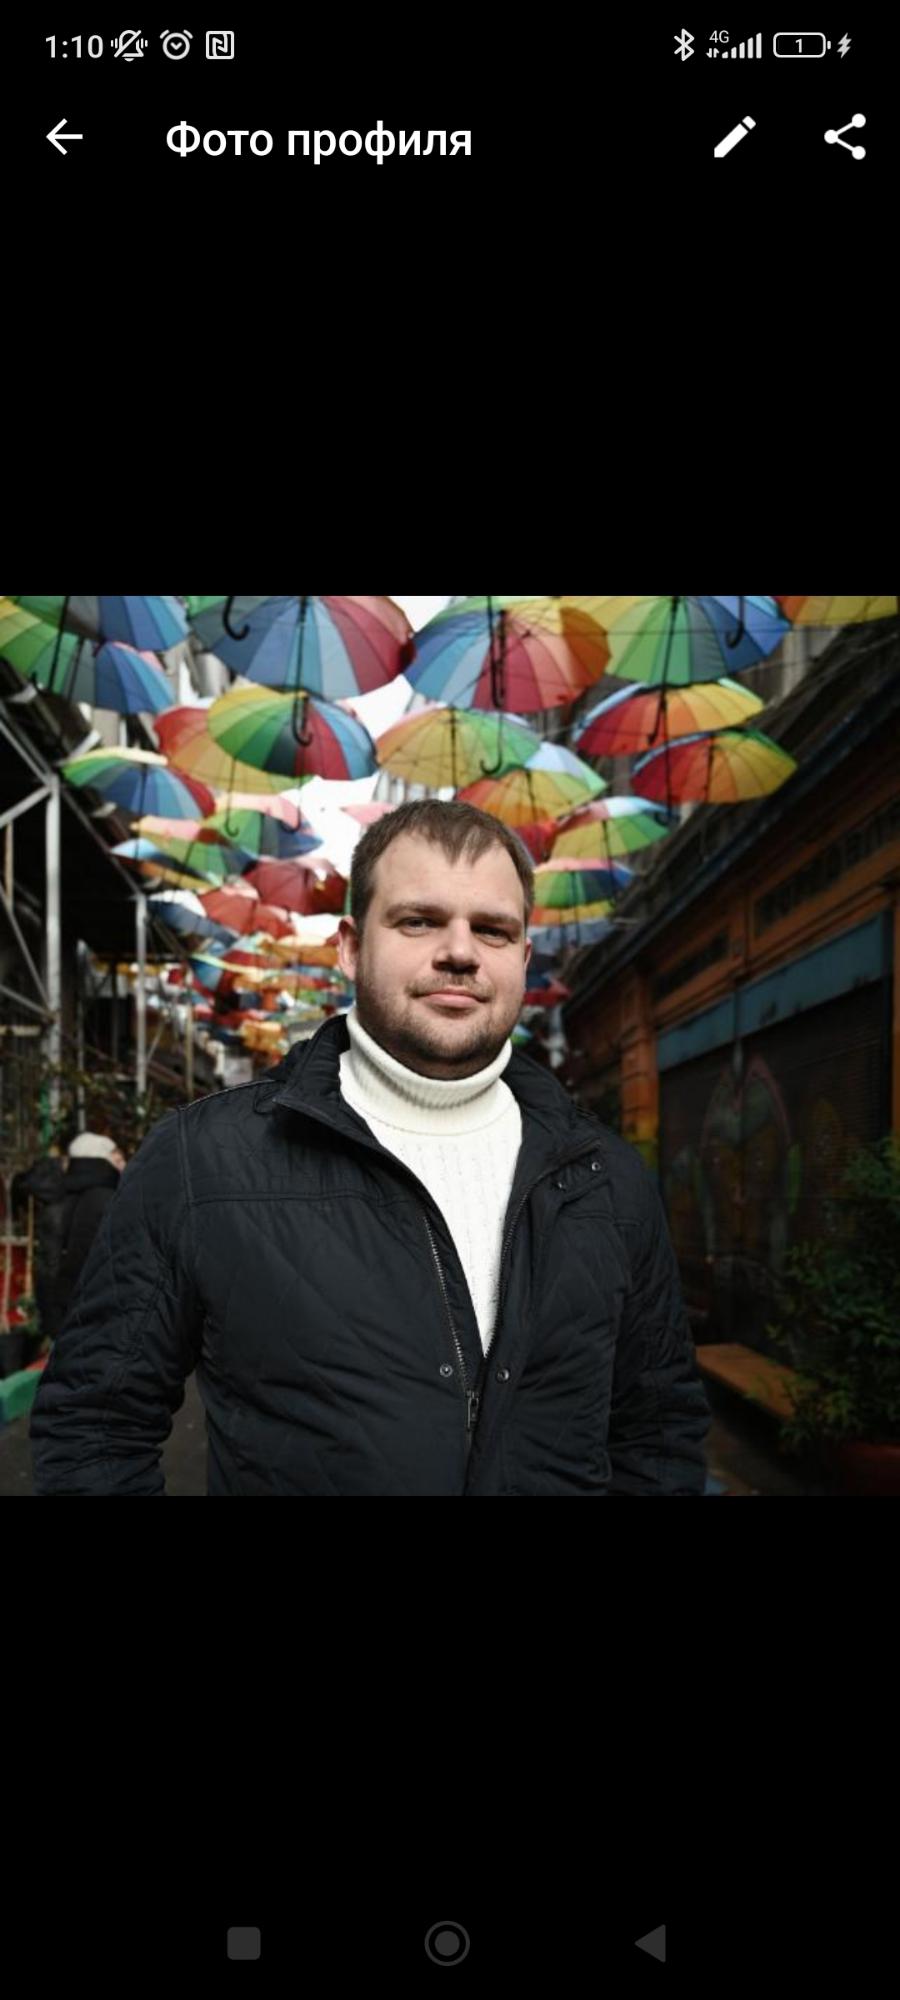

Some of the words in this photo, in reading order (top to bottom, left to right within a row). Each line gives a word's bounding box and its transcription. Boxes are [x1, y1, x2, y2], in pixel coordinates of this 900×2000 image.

[45, 34, 104, 59] 1:10
[709, 29, 730, 44] 4G
[795, 38, 803, 54] 1
[166, 120, 274, 158] Фото
[287, 119, 472, 166] профиля
